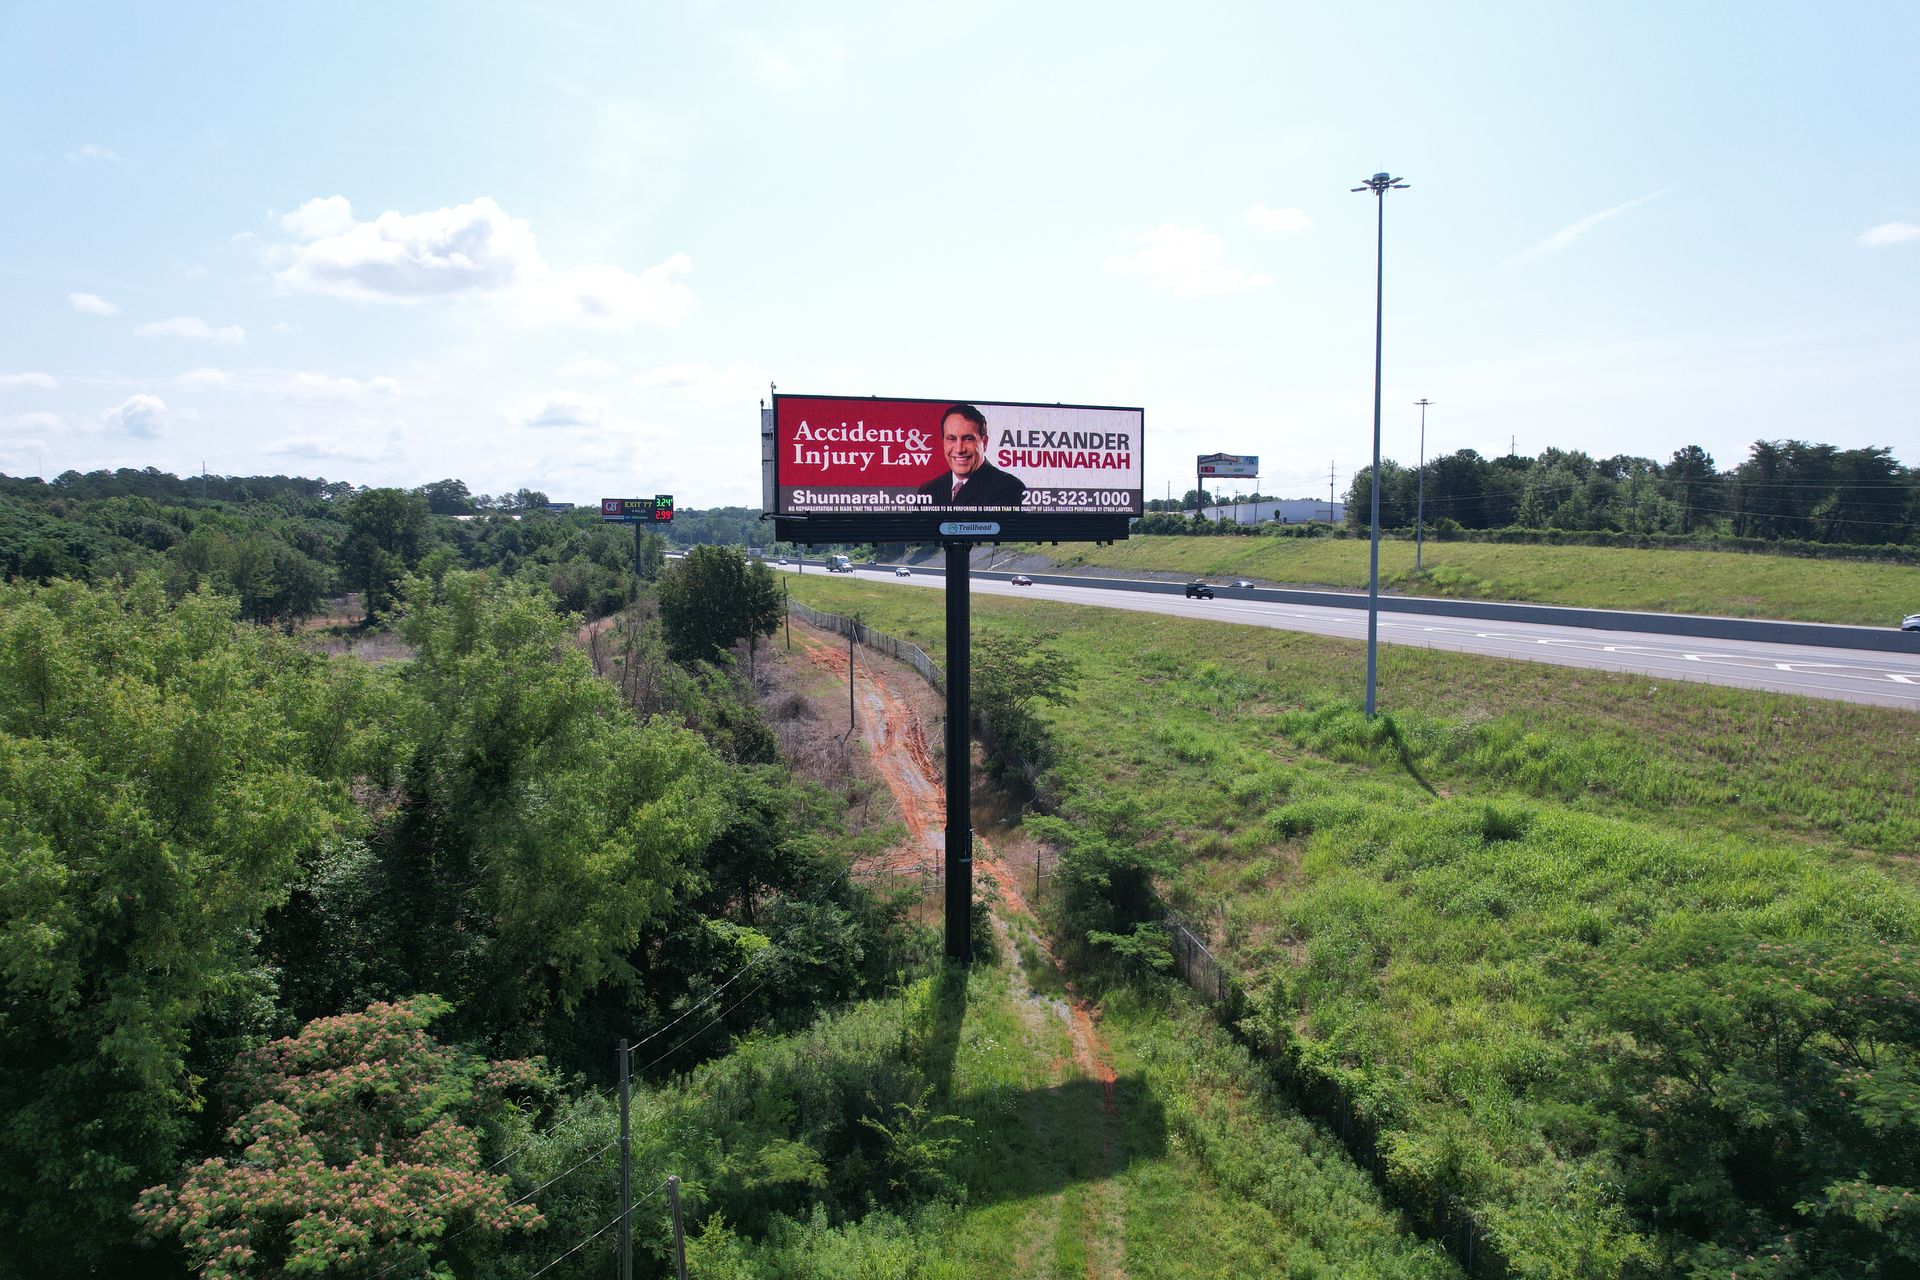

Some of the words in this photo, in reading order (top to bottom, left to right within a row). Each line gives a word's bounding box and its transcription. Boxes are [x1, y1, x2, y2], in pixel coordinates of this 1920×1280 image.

[999, 429, 1130, 451] ALEXANDER
[793, 444, 875, 471] Injury
[881, 446, 932, 466] Law
[998, 449, 1131, 469] SHUNNARAH
[793, 489, 932, 505] Shunnarah.com
[1021, 490, 1130, 506] 205-323-1000
[606, 502, 618, 512] QT
